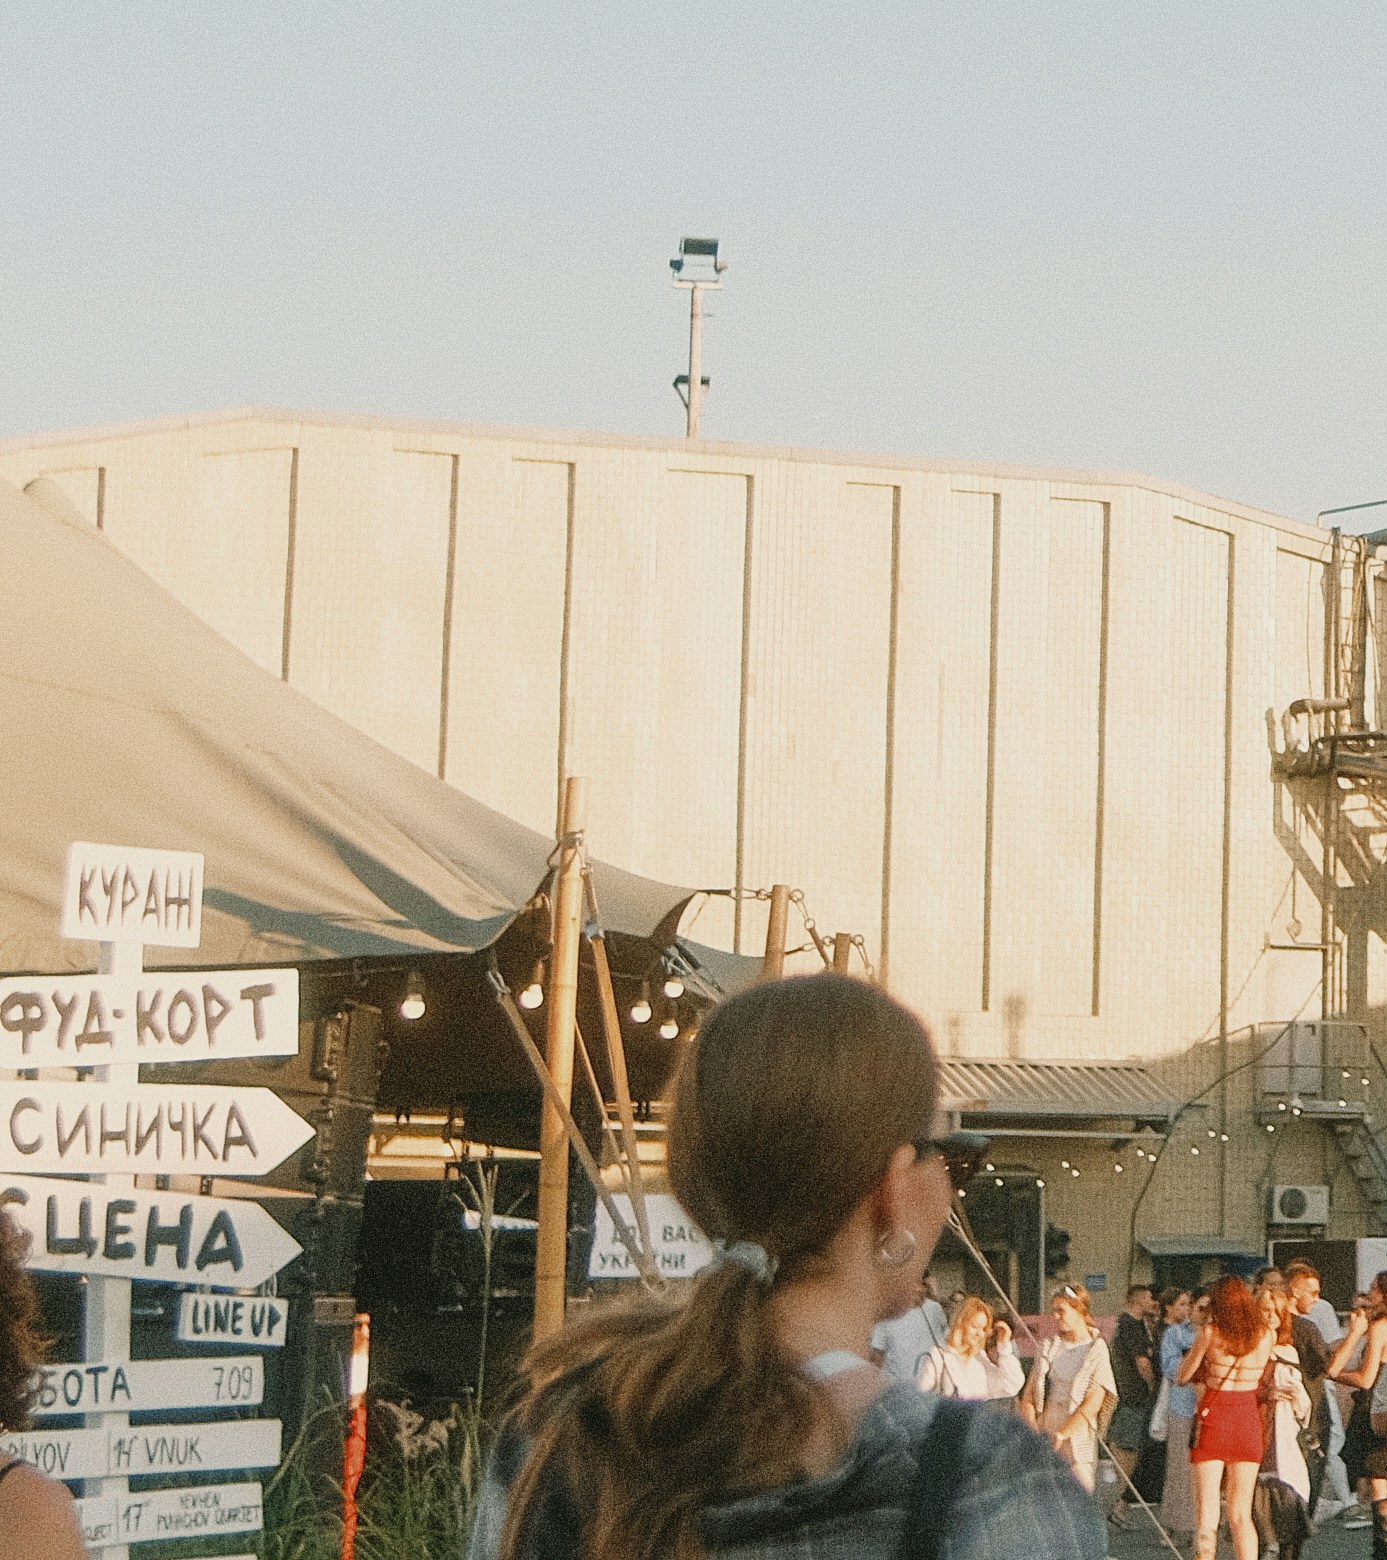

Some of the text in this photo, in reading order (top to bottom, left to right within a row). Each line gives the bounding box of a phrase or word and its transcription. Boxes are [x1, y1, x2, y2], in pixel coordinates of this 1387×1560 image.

[78, 863, 195, 931] КУРАЖ
[0, 982, 277, 1055] ФУД-КОРТ
[9, 1096, 258, 1162] СИНИЧКА
[192, 1299, 282, 1337] LINE UP
[145, 1435, 202, 1466] VNUK
